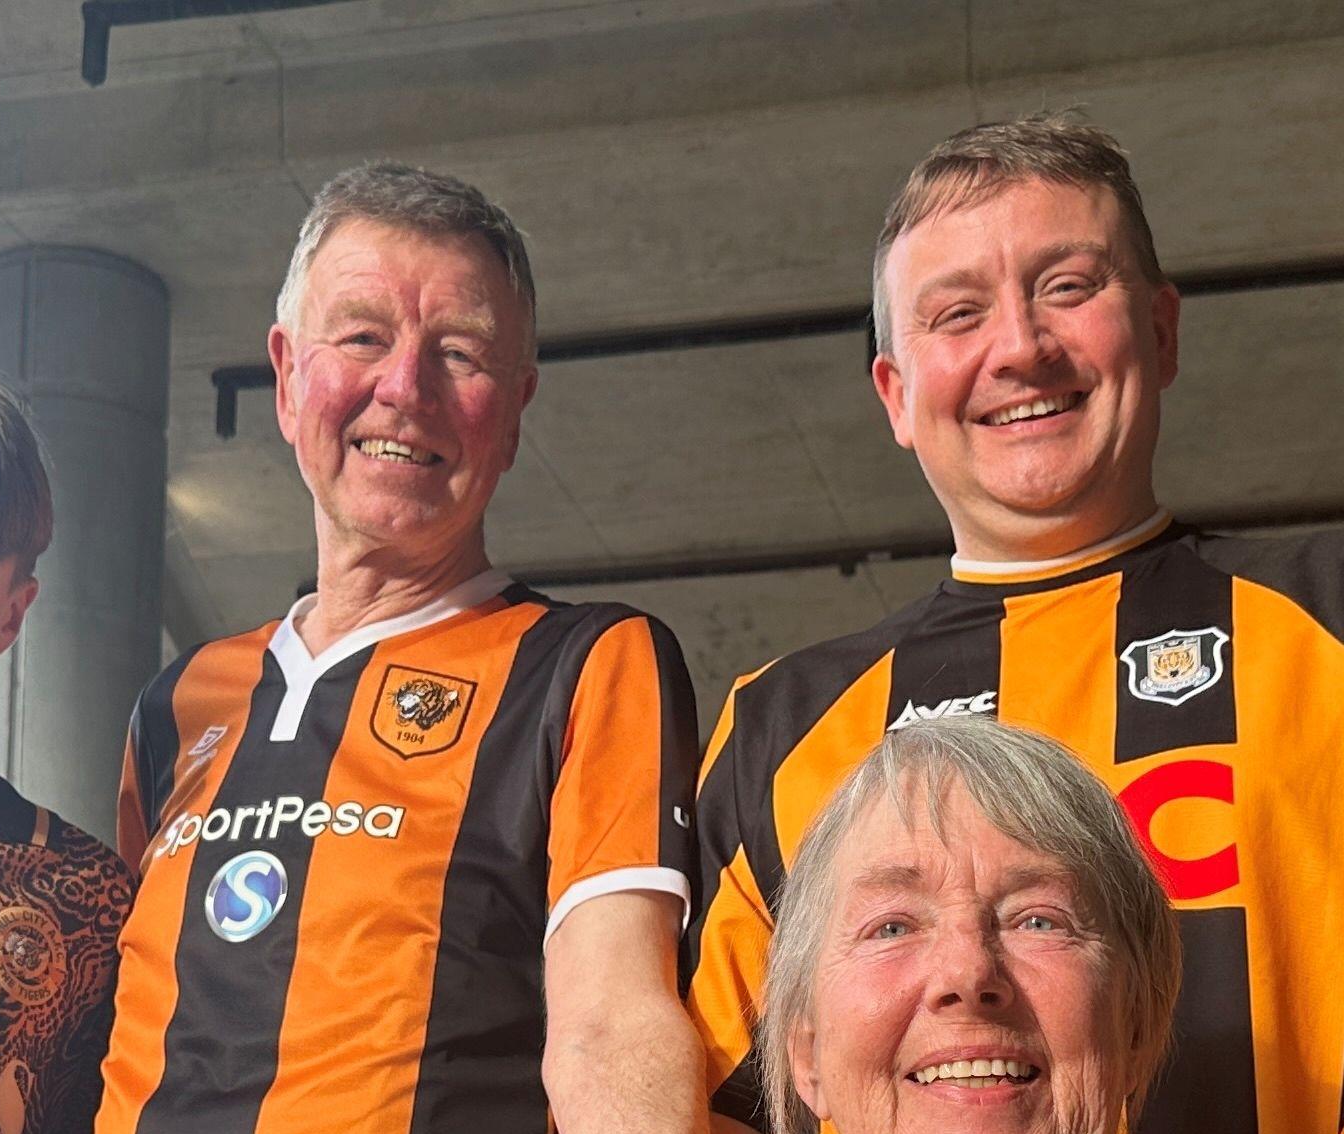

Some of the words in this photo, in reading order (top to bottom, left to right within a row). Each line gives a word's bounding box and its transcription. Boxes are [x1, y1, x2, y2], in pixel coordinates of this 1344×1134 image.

[886, 691, 997, 731] AVEC
[396, 731, 425, 744] 1904
[155, 796, 405, 858] SportPesa
[22, 909, 49, 928] CITY
[17, 985, 51, 1001] TIGERS
